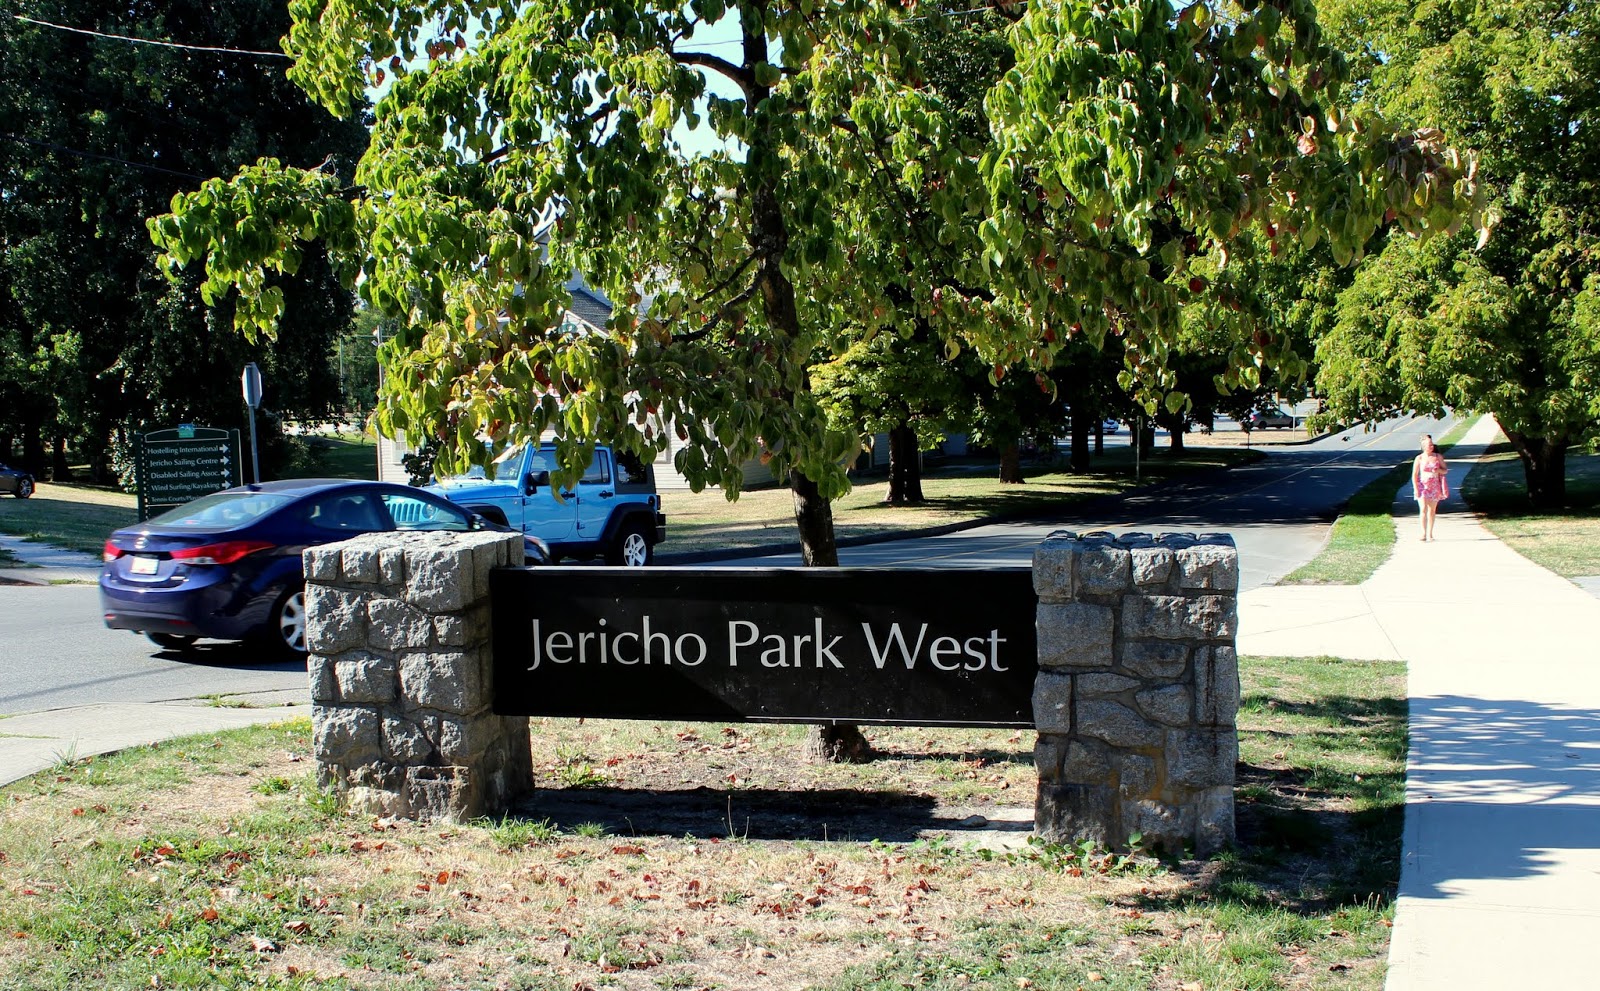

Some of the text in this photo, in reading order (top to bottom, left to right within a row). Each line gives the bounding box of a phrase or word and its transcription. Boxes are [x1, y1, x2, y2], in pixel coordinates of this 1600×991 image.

[147, 445, 219, 455] Hostelling International
[149, 459, 173, 467] Jericho
[173, 458, 196, 467] Sailing
[150, 471, 178, 479] Disabled
[179, 470, 200, 478] Sailing
[169, 482, 220, 491] Surfing/Kayaking
[527, 616, 1009, 672] Jericho Park West
